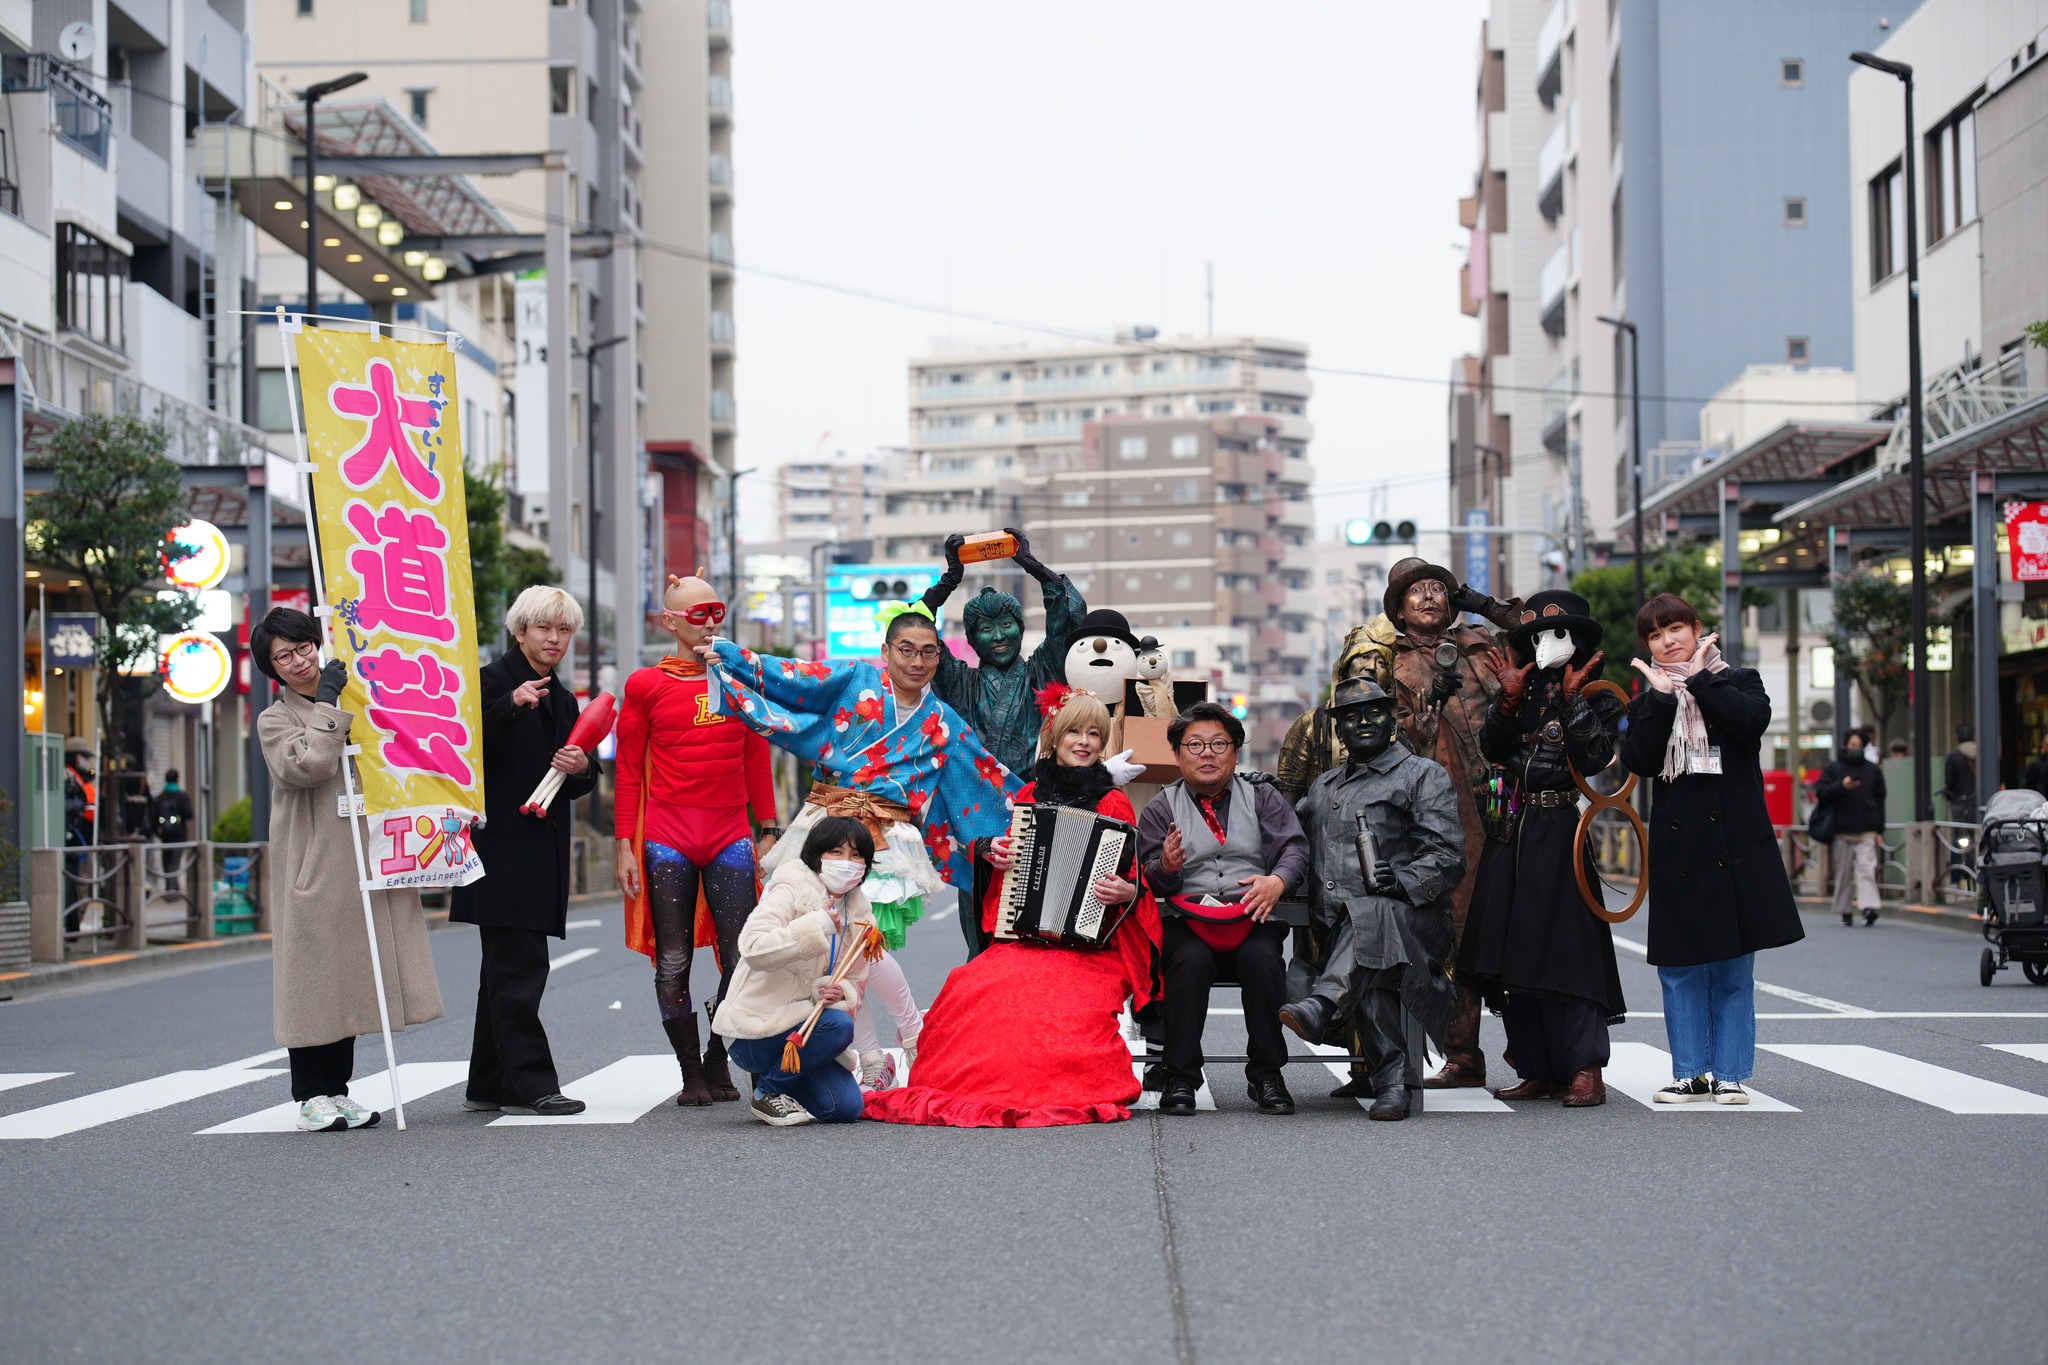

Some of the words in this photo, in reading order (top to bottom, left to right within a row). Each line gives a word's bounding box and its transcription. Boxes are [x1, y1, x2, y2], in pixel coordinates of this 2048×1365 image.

[328, 356, 478, 791] 大道芸
[1032, 845, 1047, 891] EXCELSIOR
